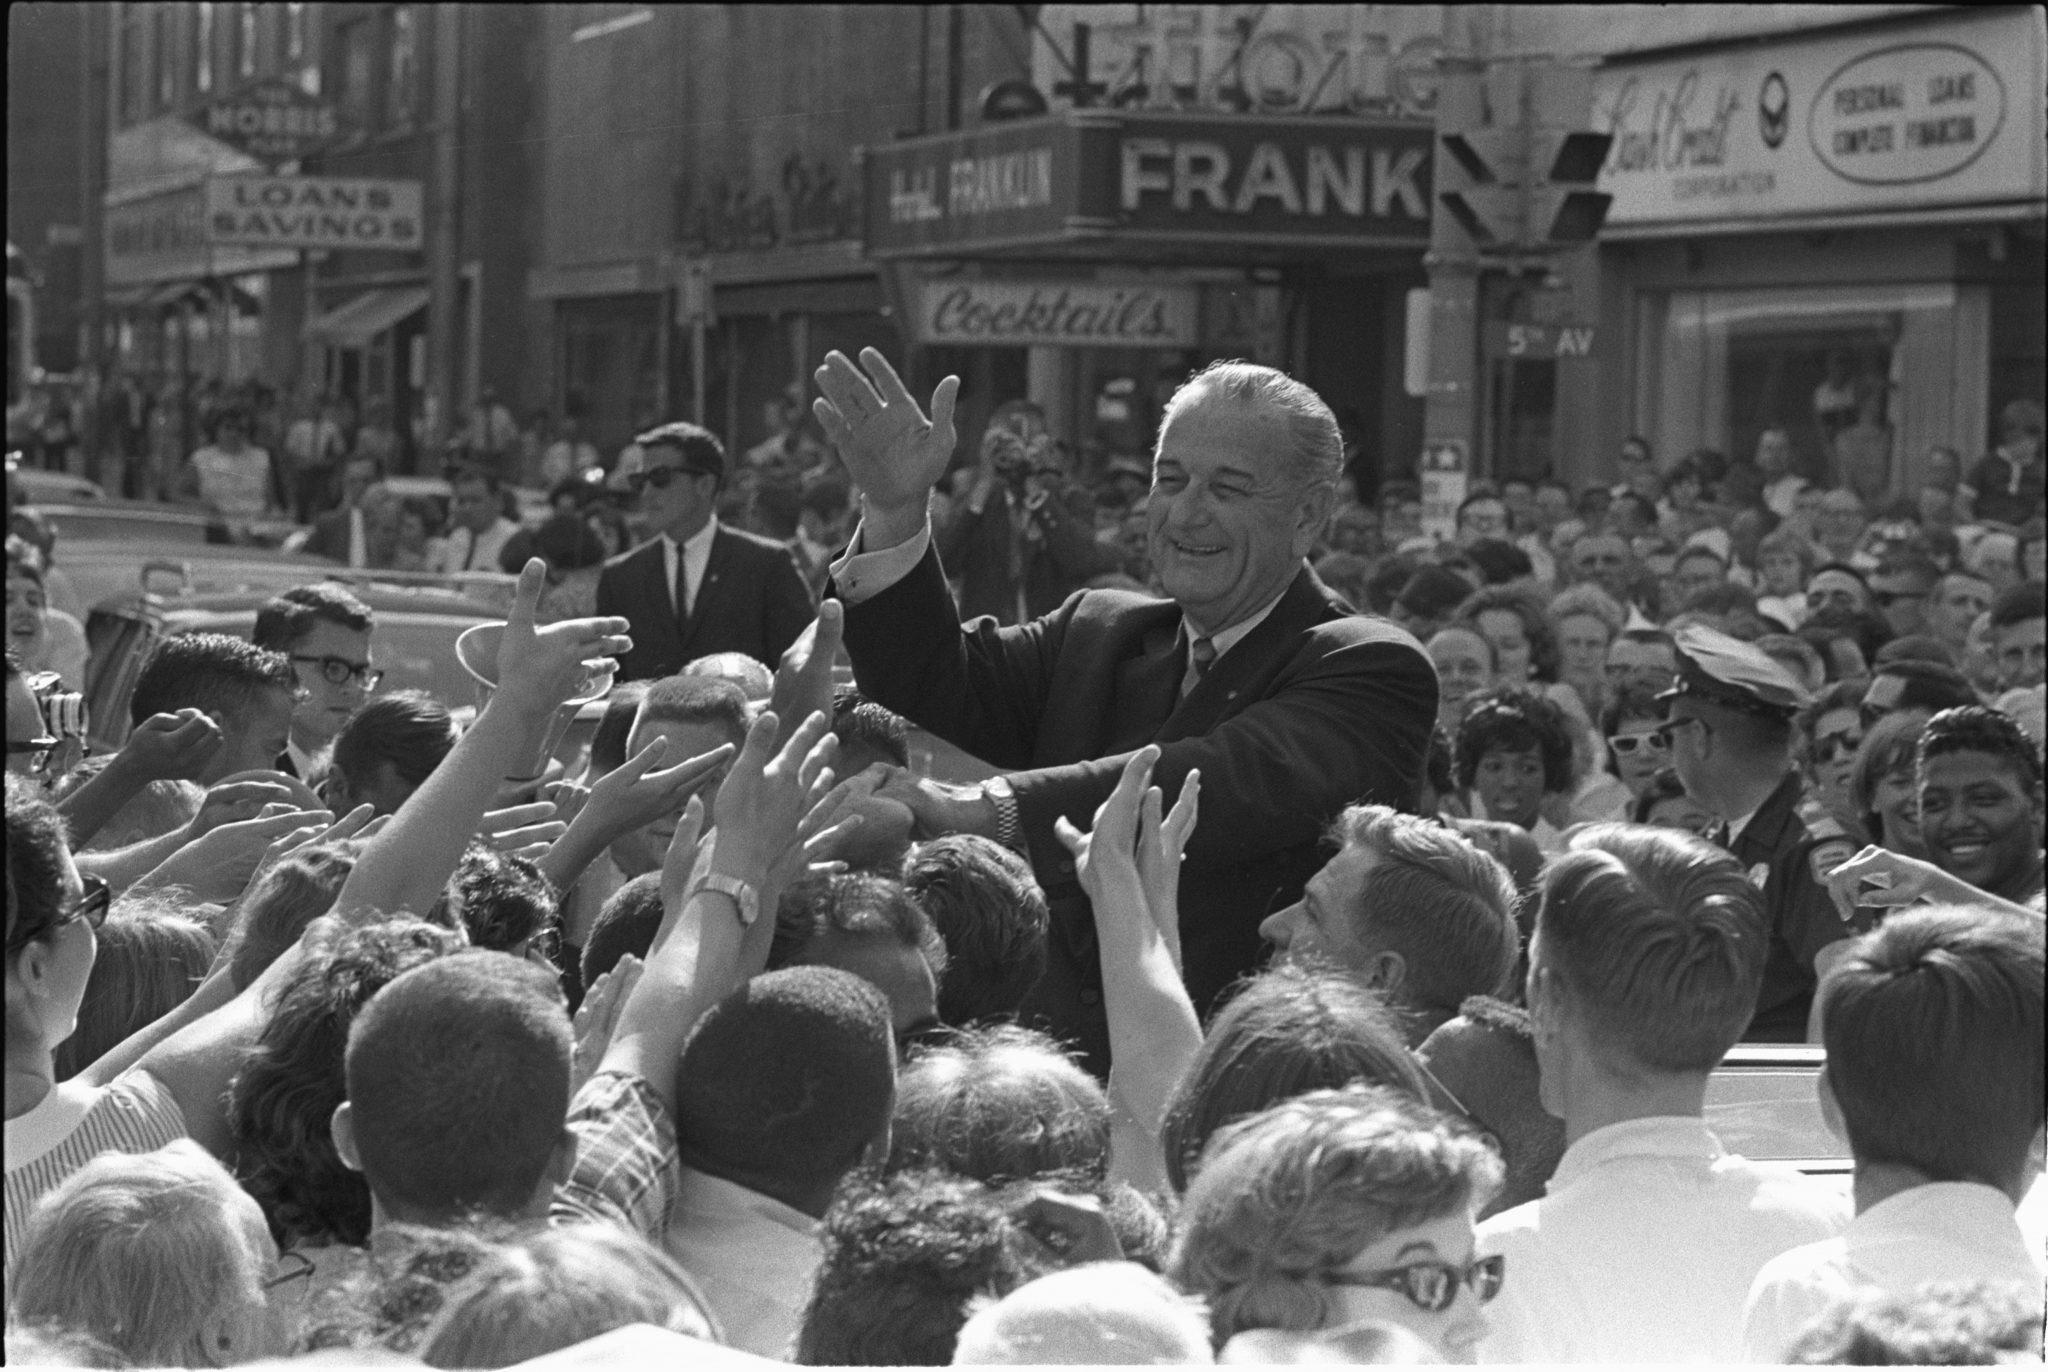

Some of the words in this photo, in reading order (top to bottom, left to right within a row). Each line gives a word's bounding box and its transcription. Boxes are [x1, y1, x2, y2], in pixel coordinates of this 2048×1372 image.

[1926, 71, 1977, 107] LOANS
[233, 183, 393, 213] LOANS
[935, 287, 1177, 338] Cocktails
[1554, 326, 1596, 357] AV
